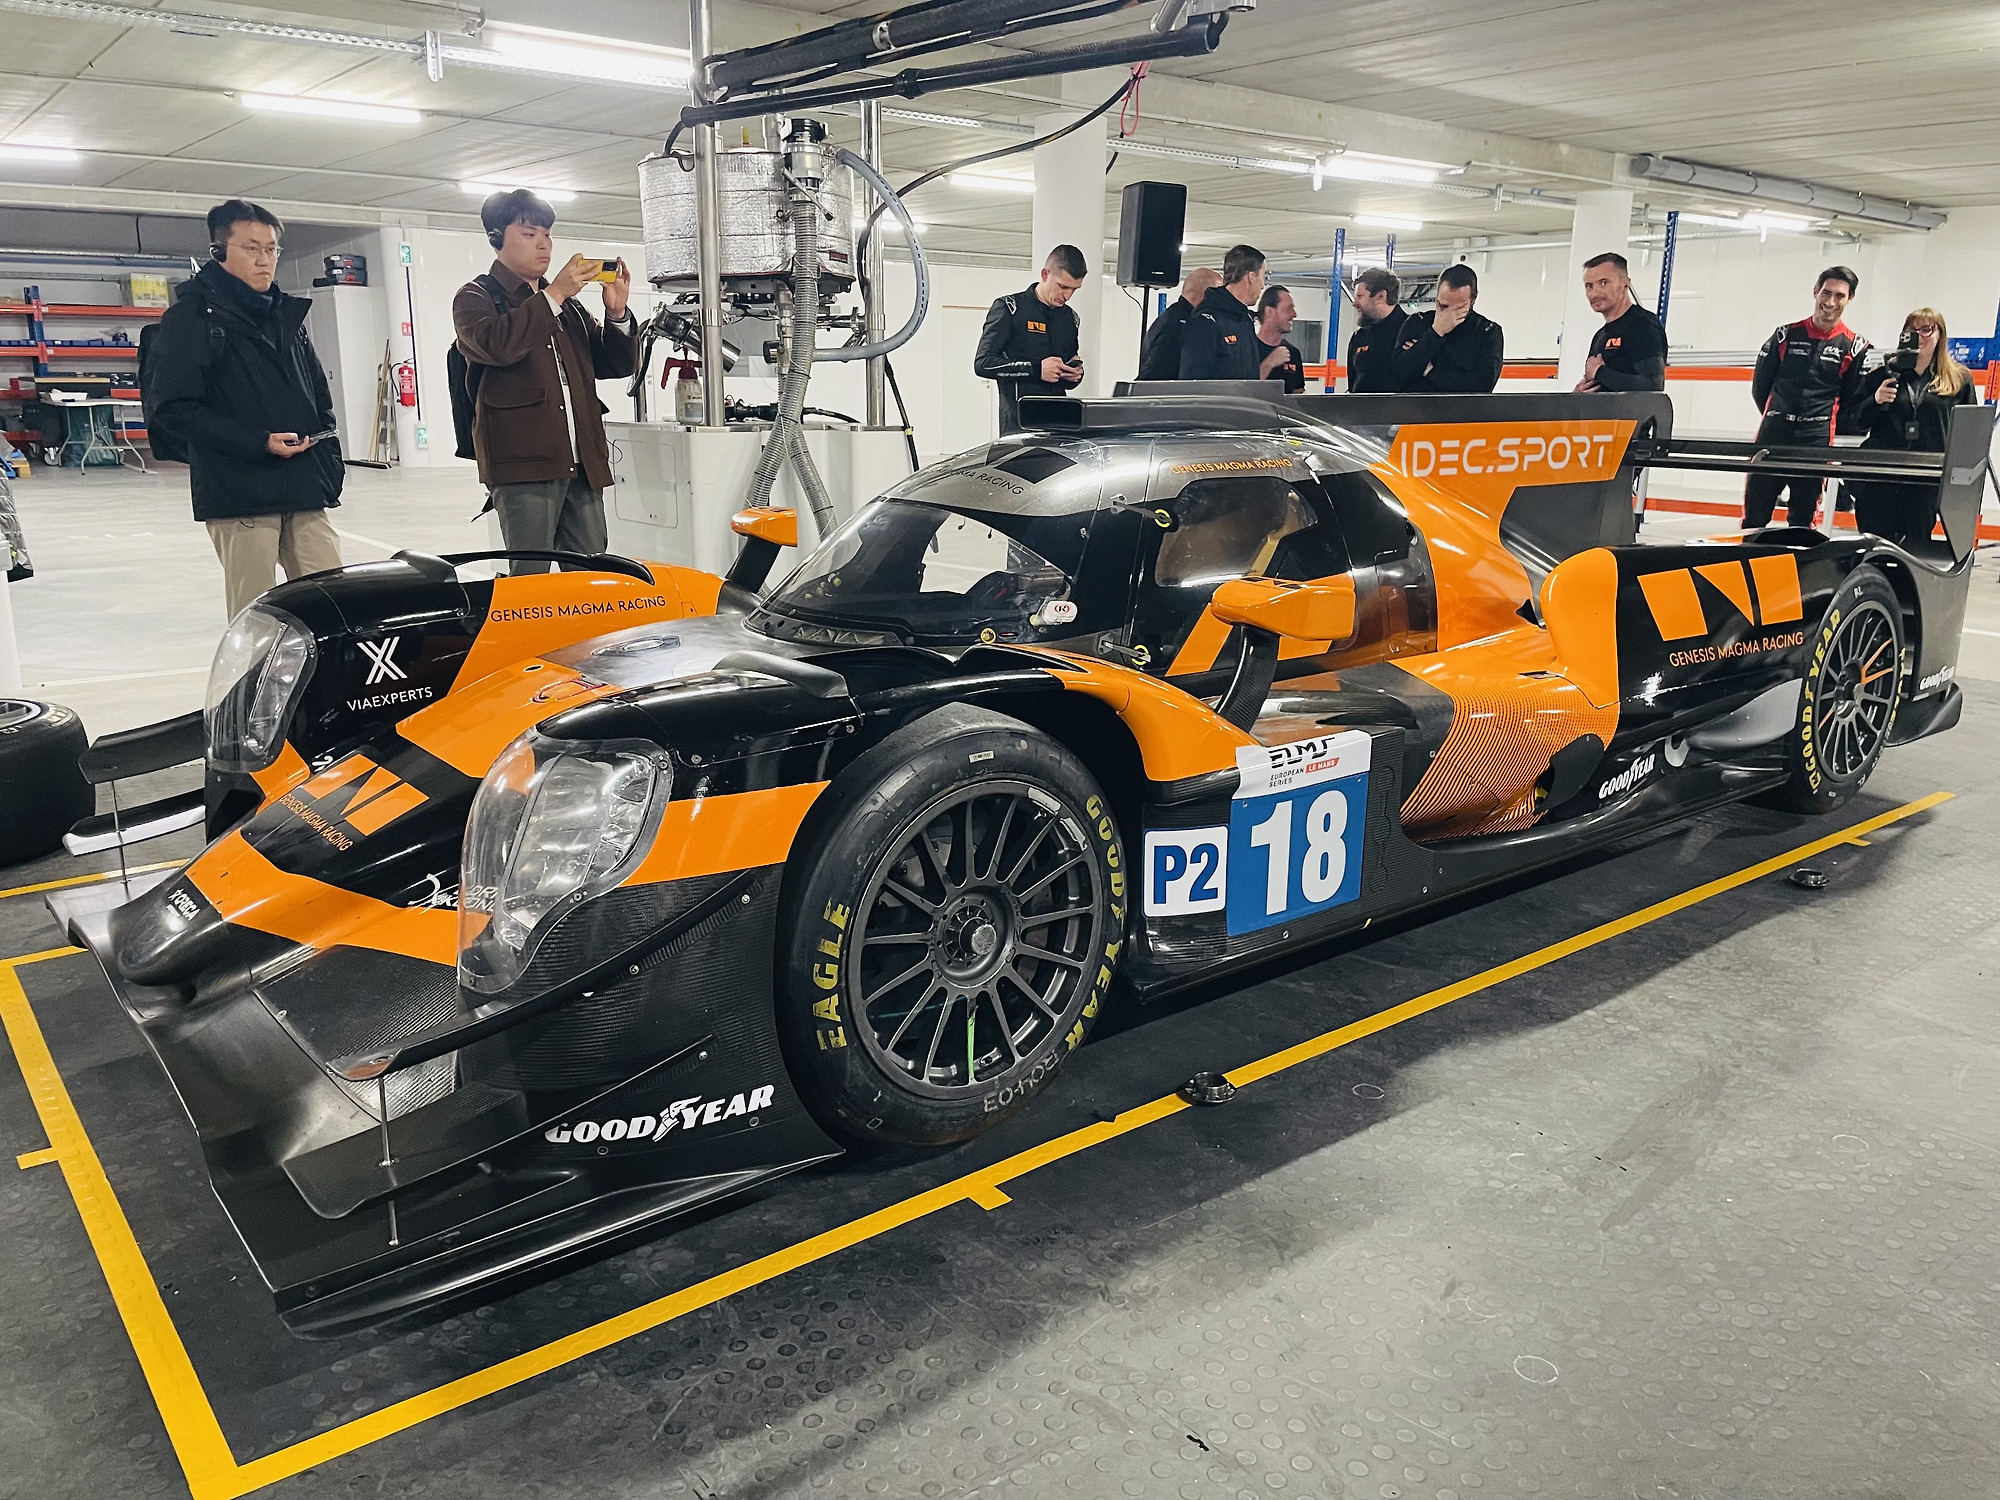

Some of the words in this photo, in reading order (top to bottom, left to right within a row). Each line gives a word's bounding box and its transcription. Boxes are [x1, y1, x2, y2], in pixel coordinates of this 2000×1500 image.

[1170, 463, 1215, 474] GENESIS
[1213, 461, 1253, 472] MAGMA
[1255, 458, 1293, 469] RACING
[1401, 434, 1613, 478] IDEC.SPORT
[976, 472, 1024, 495] RACING
[490, 606, 553, 622] GENESIS
[557, 601, 615, 617] MAGMA
[618, 595, 666, 612] RACING
[1669, 646, 1716, 668] GENESIS
[1716, 639, 1760, 660] MAGMA
[1762, 631, 1804, 652] RACING
[346, 686, 433, 711] VIAEXPERTS
[1268, 777, 1293, 788] SERIES
[1270, 768, 1304, 781] EUROPEAN
[1308, 763, 1317, 772] LE
[1317, 759, 1335, 770] MANS
[279, 793, 308, 815] GENESIS
[301, 805, 328, 832] MAGMA
[320, 824, 354, 851] RACING
[1250, 789, 1349, 916] 18
[1152, 842, 1220, 905] P2
[812, 898, 851, 1051] EAGLE
